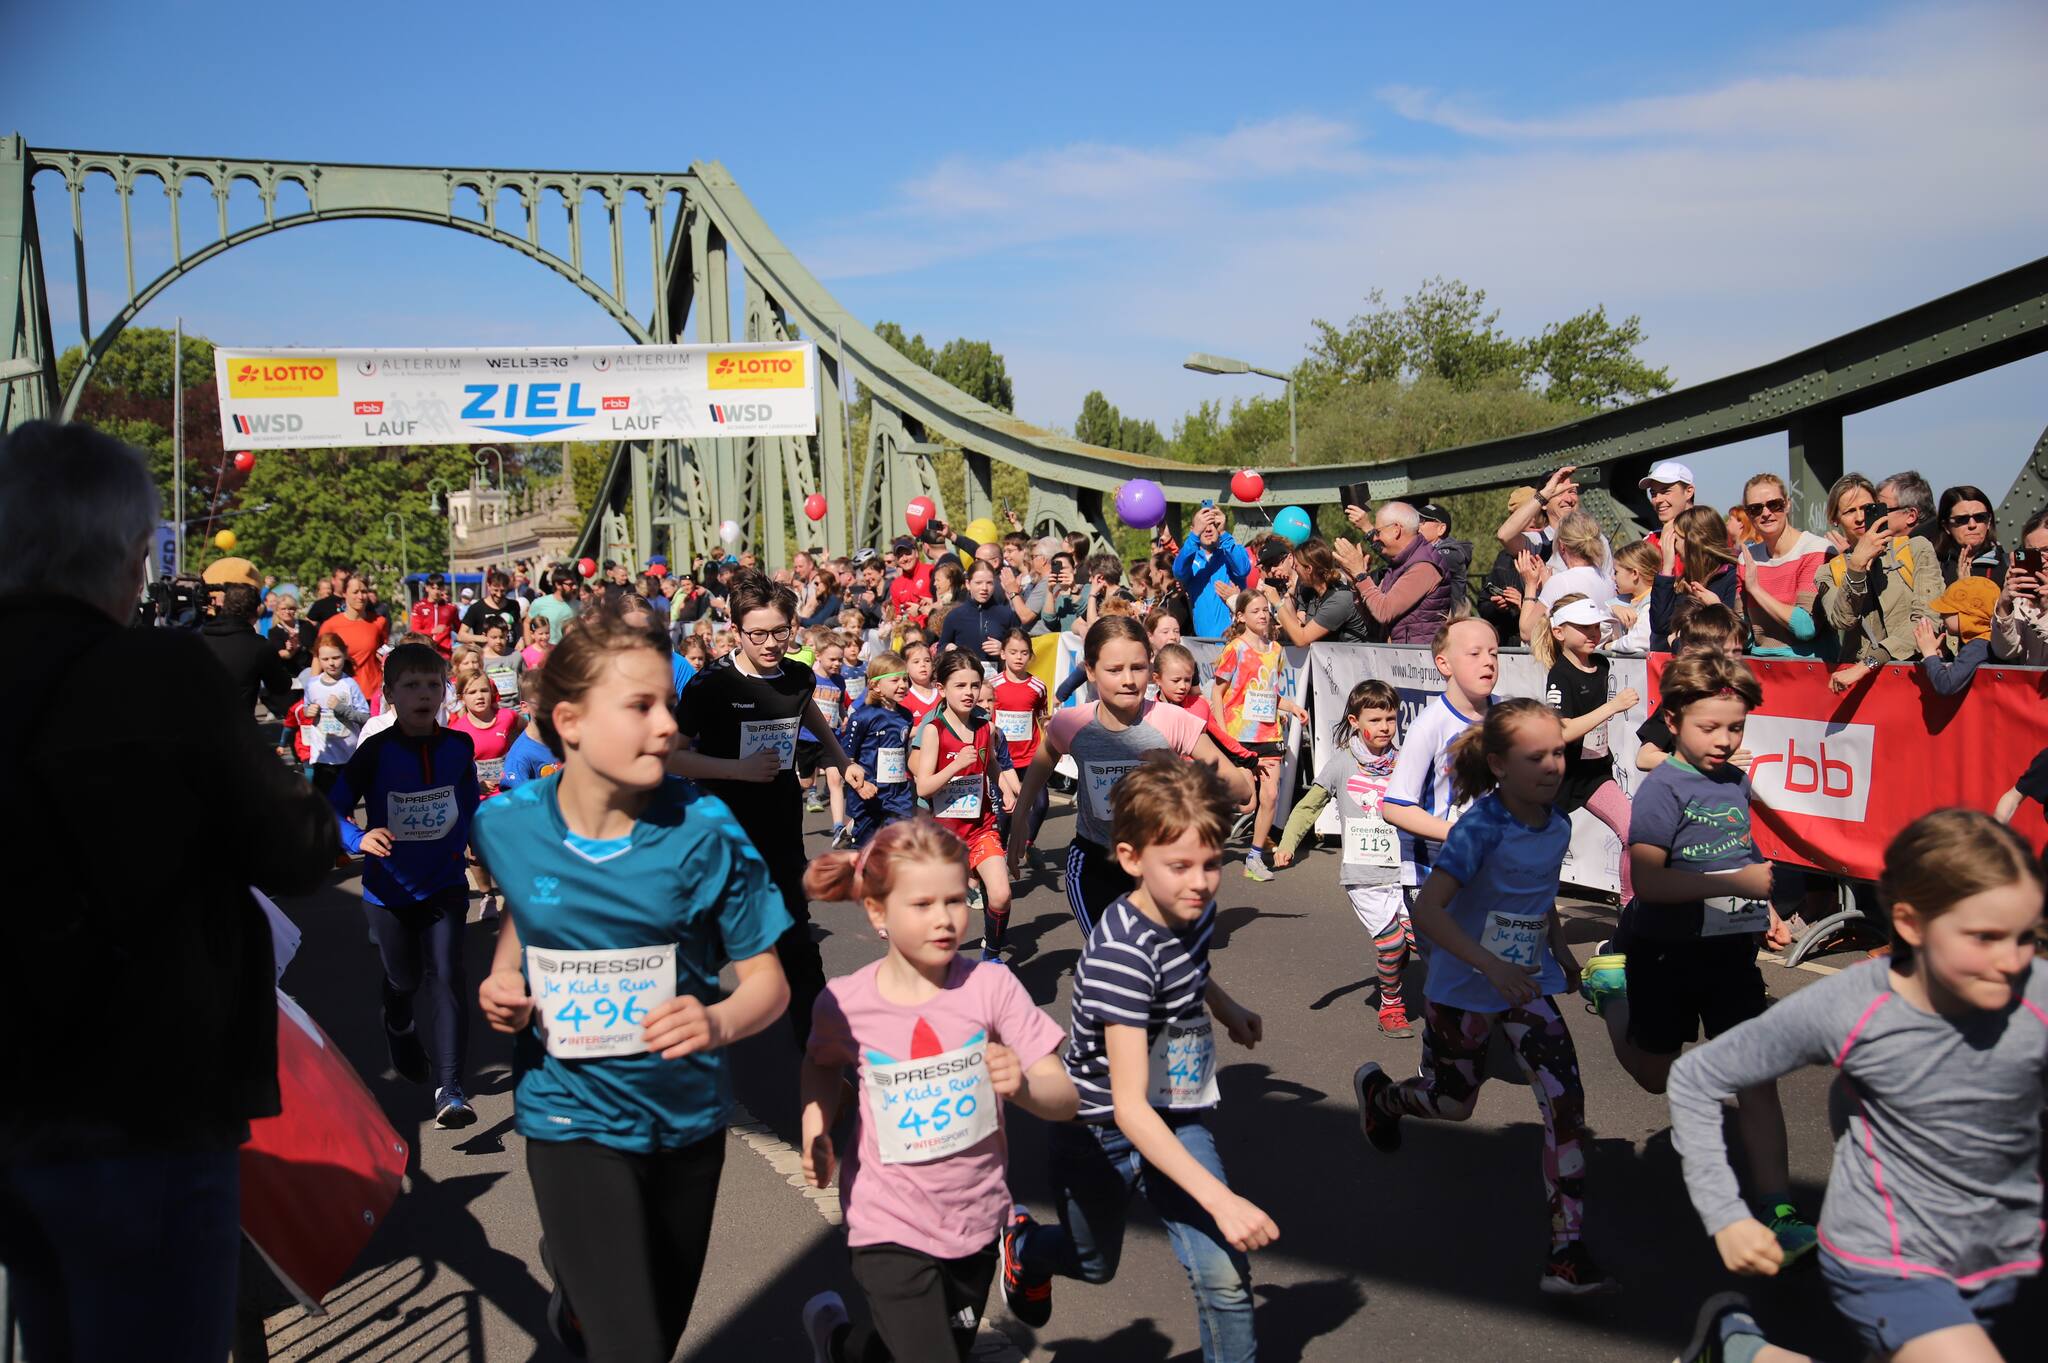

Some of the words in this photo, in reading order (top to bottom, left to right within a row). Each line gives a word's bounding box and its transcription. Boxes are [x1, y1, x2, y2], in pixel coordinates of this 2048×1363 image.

[382, 359, 461, 370] ALTERUM
[486, 358, 568, 368] WELLBERG
[616, 353, 690, 366] ALTERUM
[738, 359, 793, 374] LOTTO
[263, 366, 324, 382] LOTTO
[355, 402, 382, 414] rbb
[461, 382, 596, 419] ZIEL
[604, 399, 628, 409] rbb
[722, 404, 773, 423] WSD
[247, 413, 303, 433] WSD
[365, 421, 418, 436] LAUF
[612, 416, 662, 430] LAUF
[1747, 738, 1854, 798] rbb
[405, 790, 451, 804] PRESSIO
[409, 804, 429, 813] Kids
[432, 801, 448, 810] Run
[402, 809, 446, 829] 465
[1360, 838, 1391, 853] 119
[560, 954, 664, 975] PRESSIO
[568, 976, 610, 995] Kids
[619, 977, 657, 994] Run
[555, 994, 648, 1033] 496
[568, 1032, 635, 1046] INTERSPORT
[895, 1051, 983, 1084] PRESSIO
[904, 1082, 942, 1103] Kids
[948, 1074, 981, 1093] Run
[897, 1094, 977, 1138] 450
[912, 1127, 969, 1149] INTERSPORT
